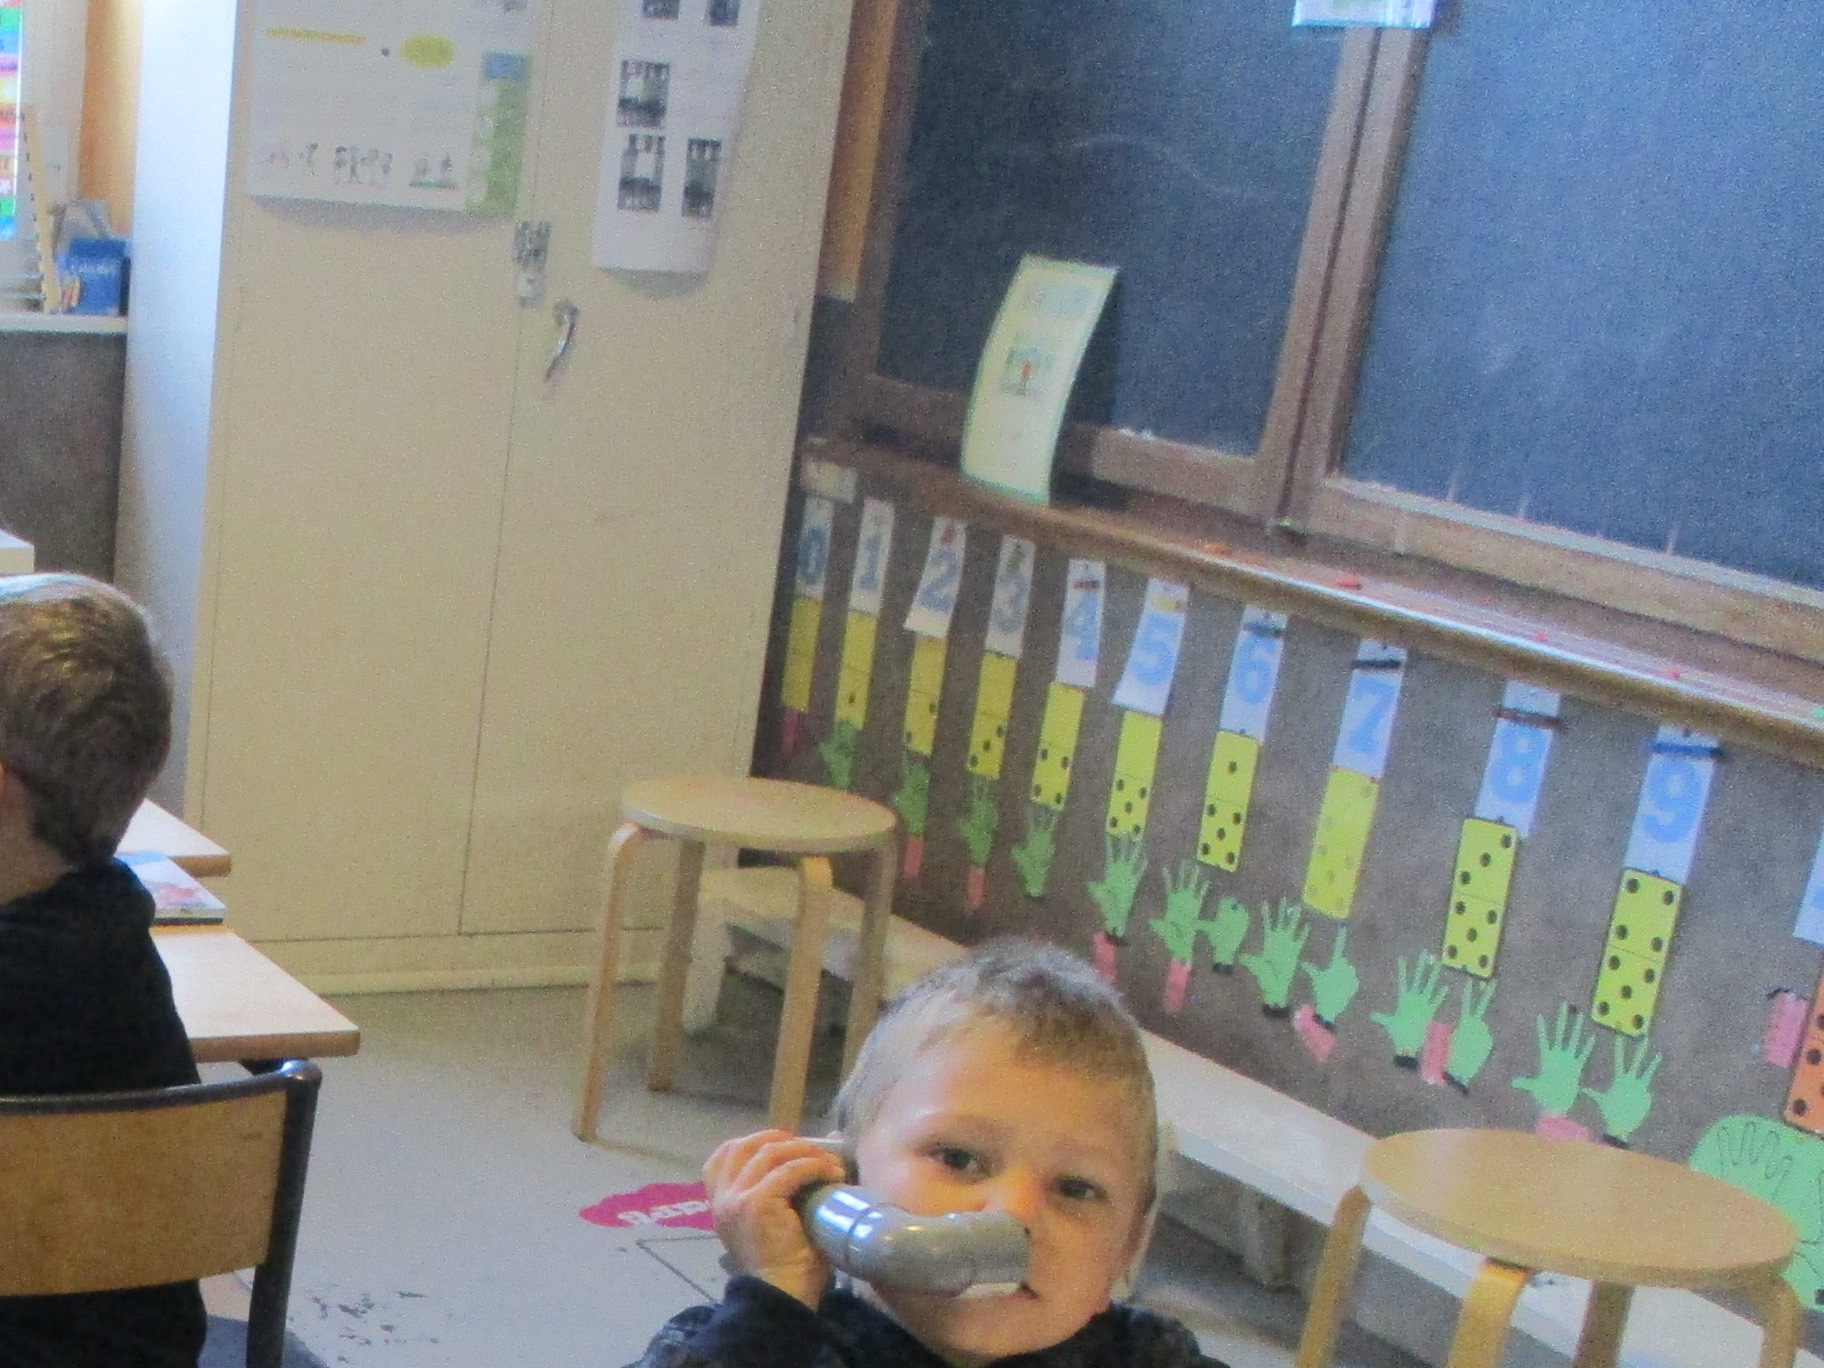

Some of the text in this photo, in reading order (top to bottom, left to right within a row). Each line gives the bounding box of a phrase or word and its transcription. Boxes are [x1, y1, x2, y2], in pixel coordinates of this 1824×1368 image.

[859, 532, 882, 591] 1
[917, 547, 958, 614] 2
[992, 571, 1030, 635] 3
[1067, 591, 1100, 661] 4
[1133, 611, 1181, 686] 5
[1232, 631, 1278, 707] 6
[1346, 677, 1400, 752] 7
[1491, 724, 1550, 805] 8
[1641, 756, 1701, 843] 9
